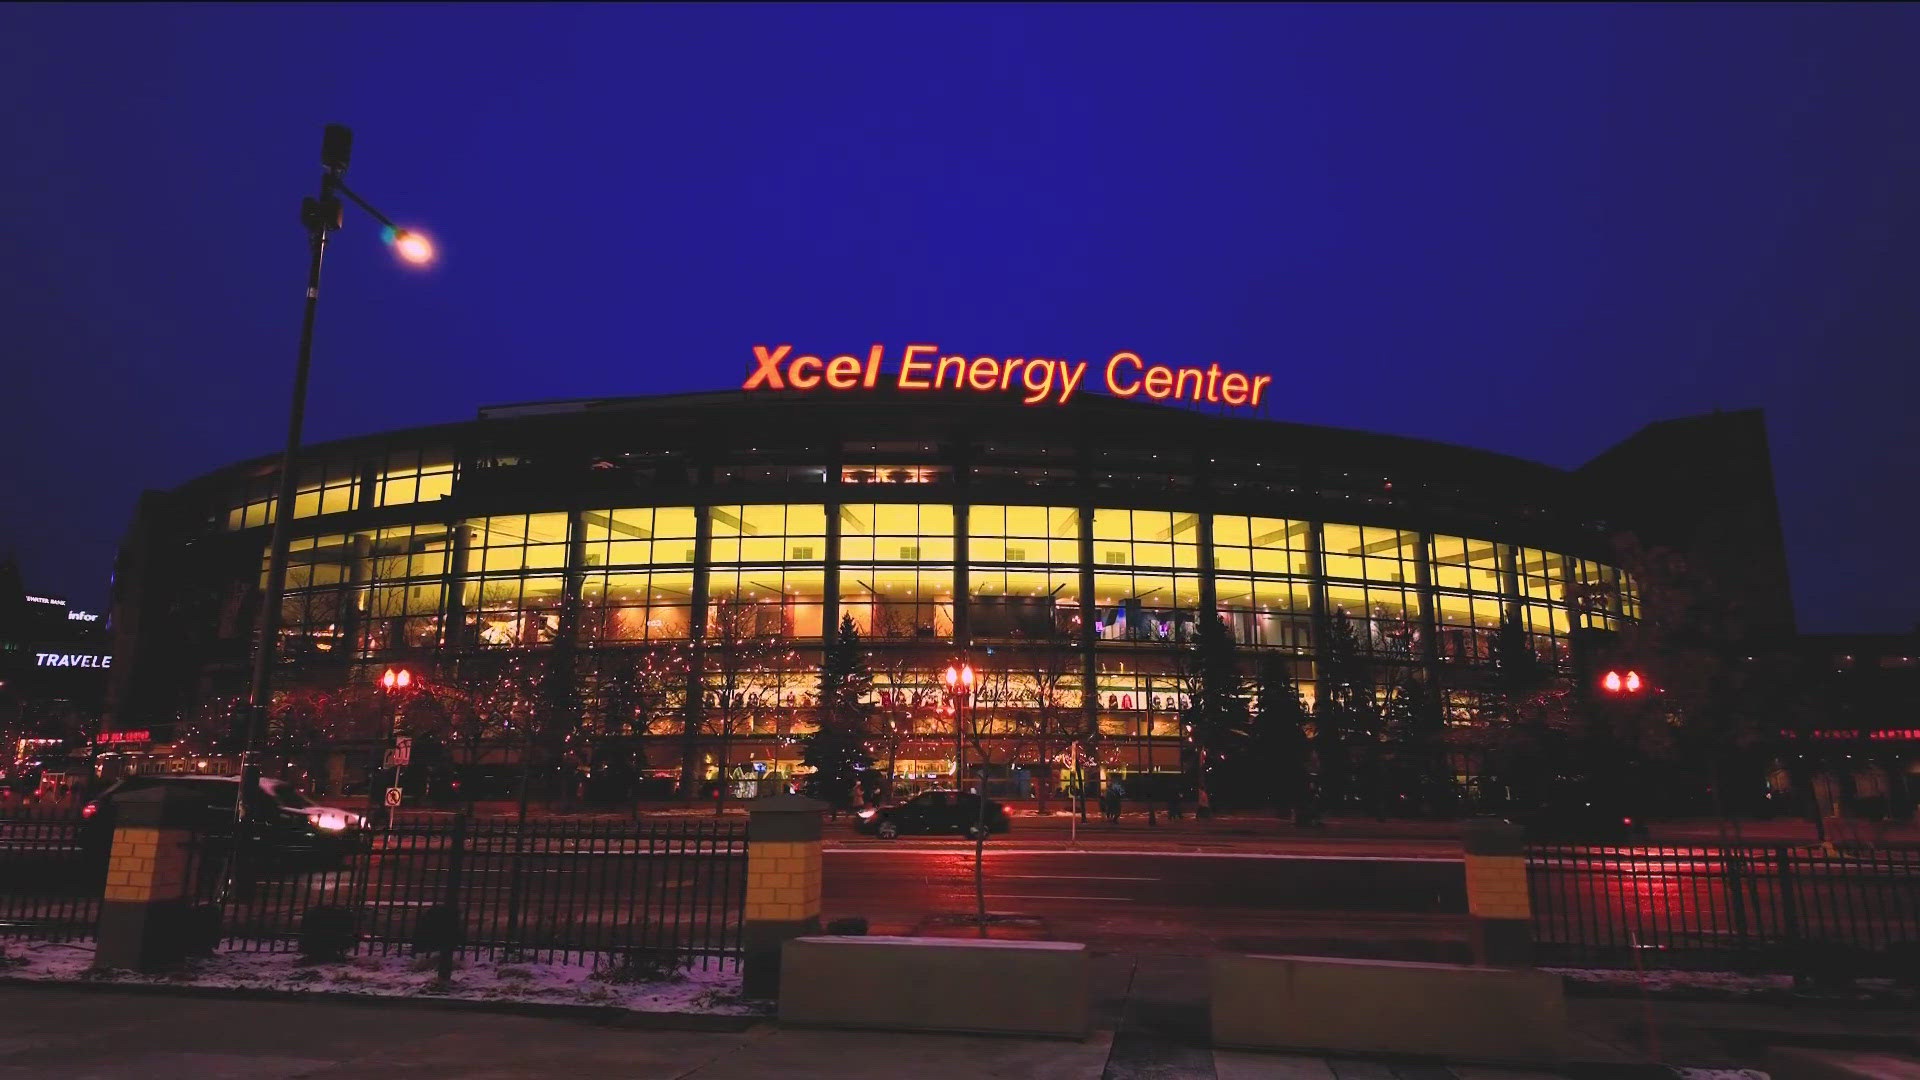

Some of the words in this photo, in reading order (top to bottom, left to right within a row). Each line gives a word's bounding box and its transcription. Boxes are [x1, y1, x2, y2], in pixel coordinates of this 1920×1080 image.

[742, 344, 884, 390] Xcel
[897, 345, 1087, 404] Energy
[1104, 352, 1272, 405] Center
[68, 610, 99, 622] infor
[36, 653, 113, 669] TRAVELE
